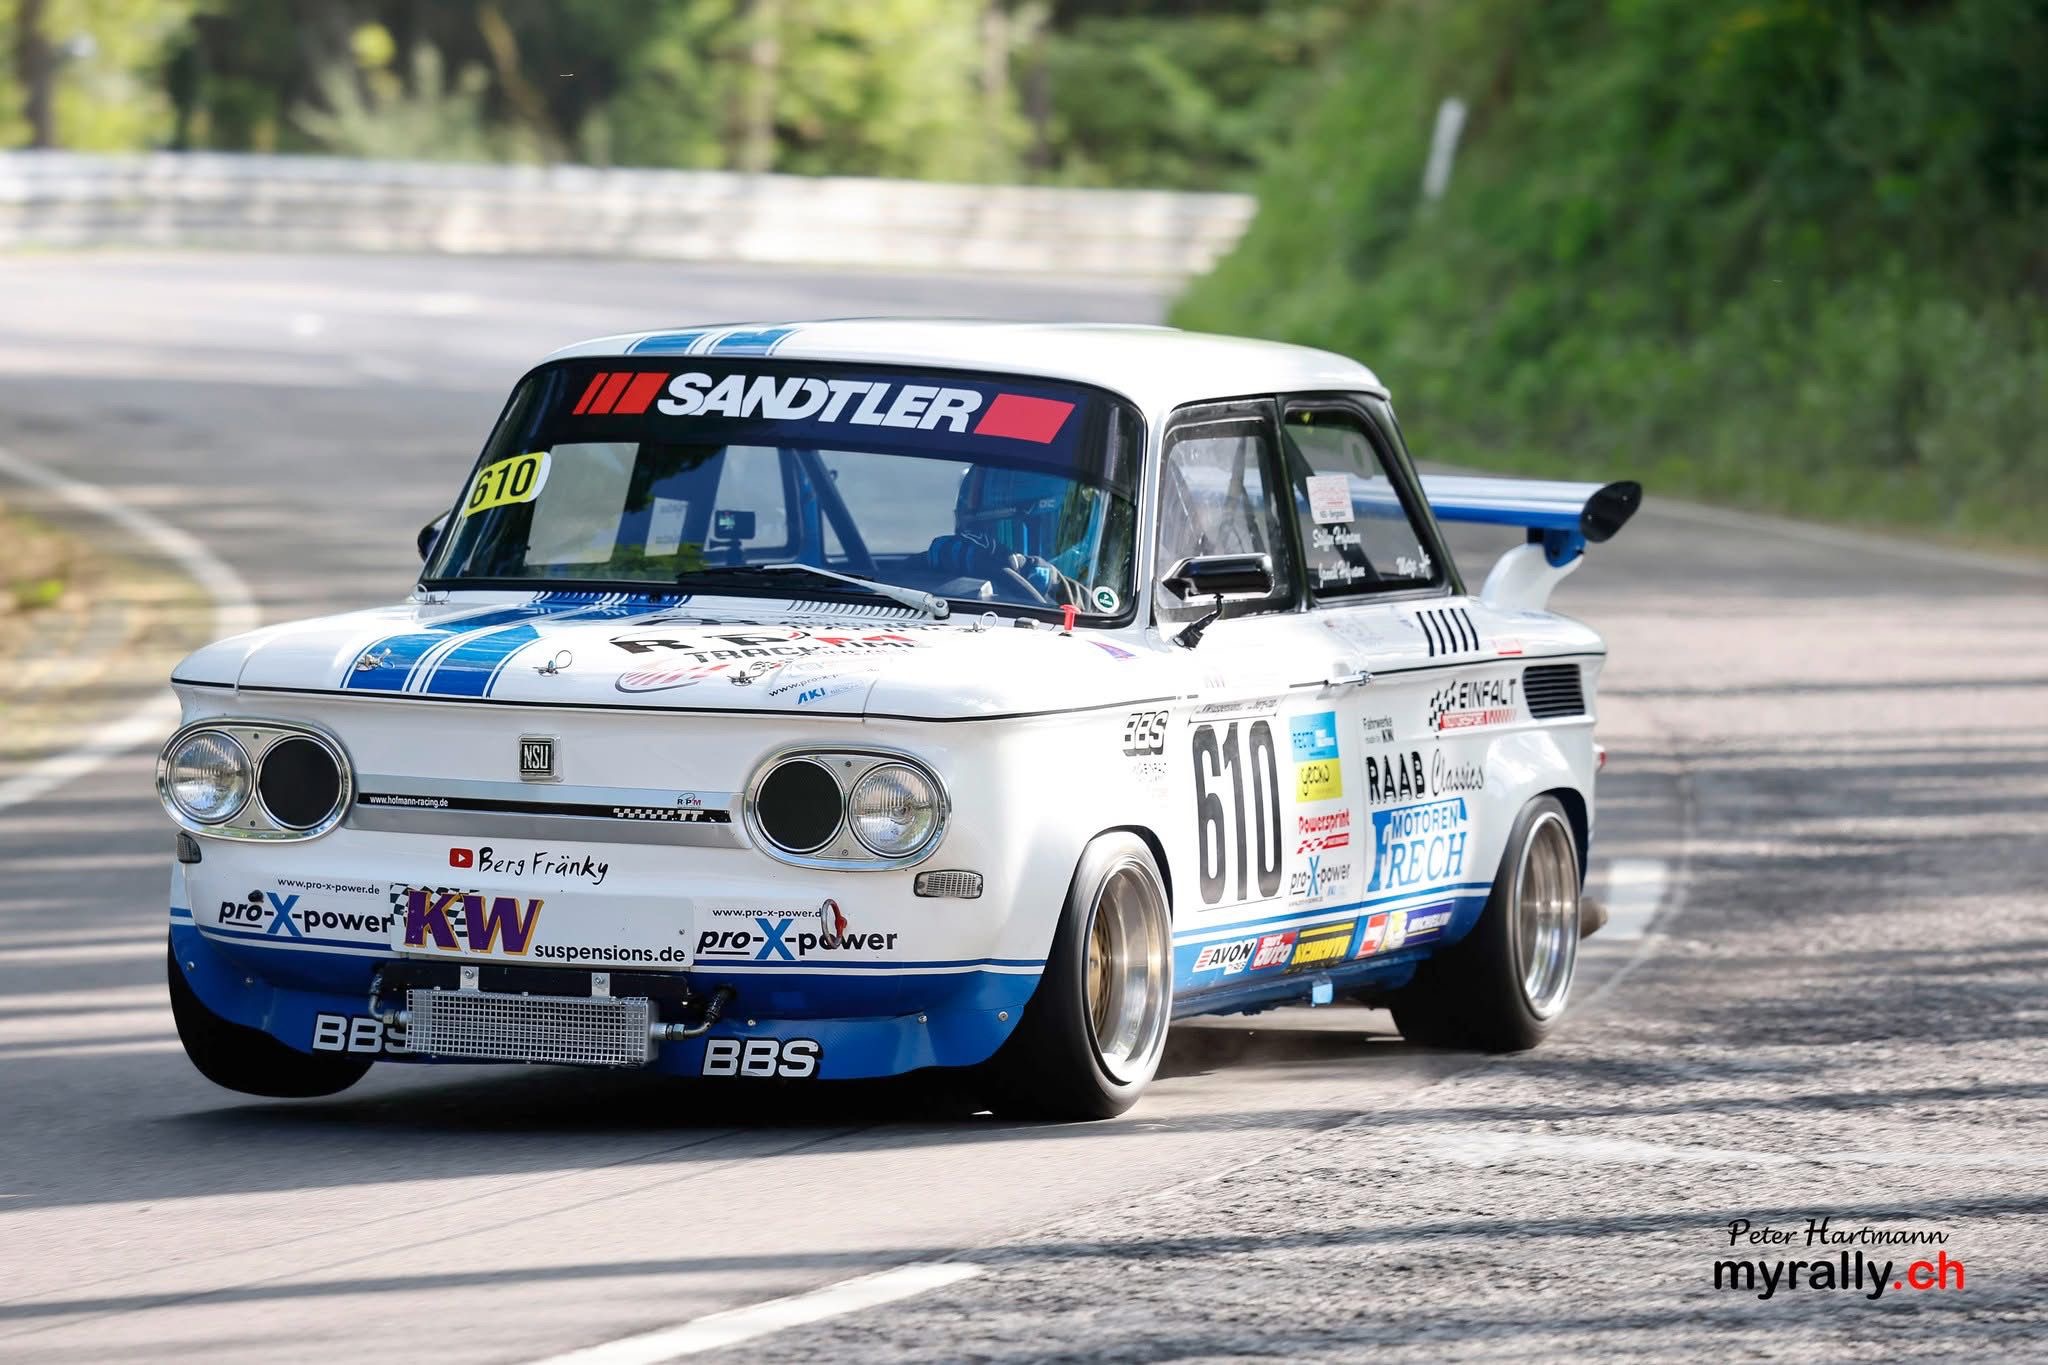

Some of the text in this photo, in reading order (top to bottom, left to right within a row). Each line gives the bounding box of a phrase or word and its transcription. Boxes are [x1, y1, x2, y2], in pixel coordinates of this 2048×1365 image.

[656, 371, 983, 434] SANDTLER
[470, 457, 534, 508] 610
[1459, 679, 1517, 709] EINFALT
[1123, 710, 1169, 757] BBS
[523, 743, 549, 770] NSU
[1365, 748, 1485, 805] RAAB Classics
[369, 794, 449, 809] www.hofmann-racing.de
[677, 809, 705, 822] TT
[1191, 718, 1283, 905] 610
[1297, 808, 1350, 834] Powersprint
[1391, 804, 1459, 840] MOTOREN
[478, 847, 609, 886] Berg Fränky
[1367, 812, 1467, 893] FRECH
[277, 877, 381, 896] www.pro-x-power.de
[402, 888, 545, 957] KW
[712, 907, 824, 920] www.pro-x-power.d
[534, 942, 685, 963] suspensions.de
[1208, 941, 1256, 966] AVON
[702, 1038, 820, 1078] BBS
